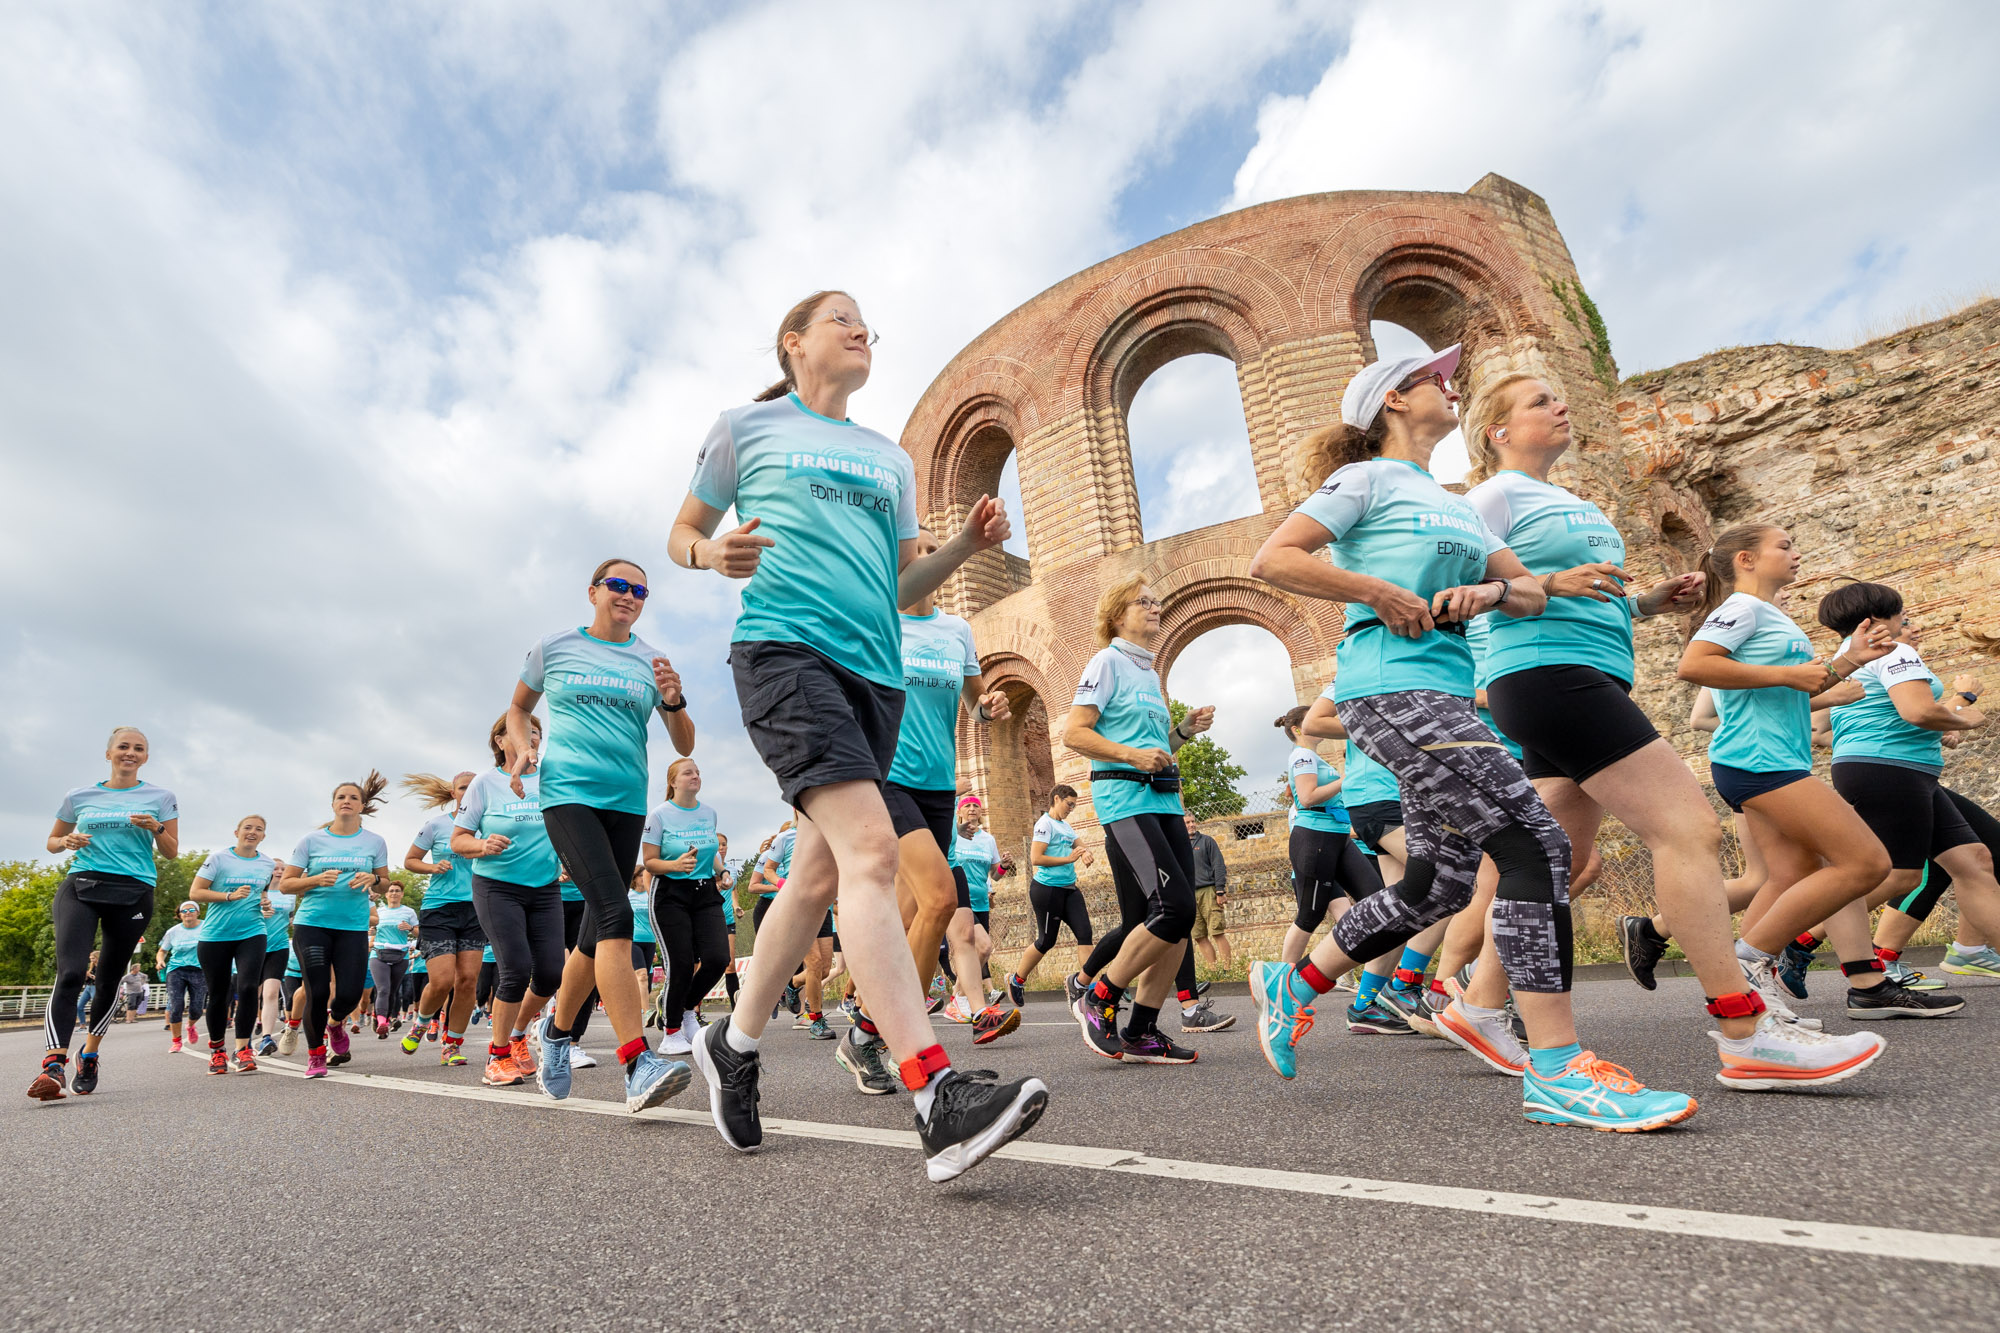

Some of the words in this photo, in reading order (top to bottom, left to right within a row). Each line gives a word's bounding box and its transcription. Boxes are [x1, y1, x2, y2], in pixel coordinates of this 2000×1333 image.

[810, 484, 843, 504] EDITH
[1437, 541, 1468, 558] EDITH
[1588, 536, 1610, 548] EDITH
[566, 674, 646, 693] FRAUENLAUF
[576, 694, 603, 706] EDITH
